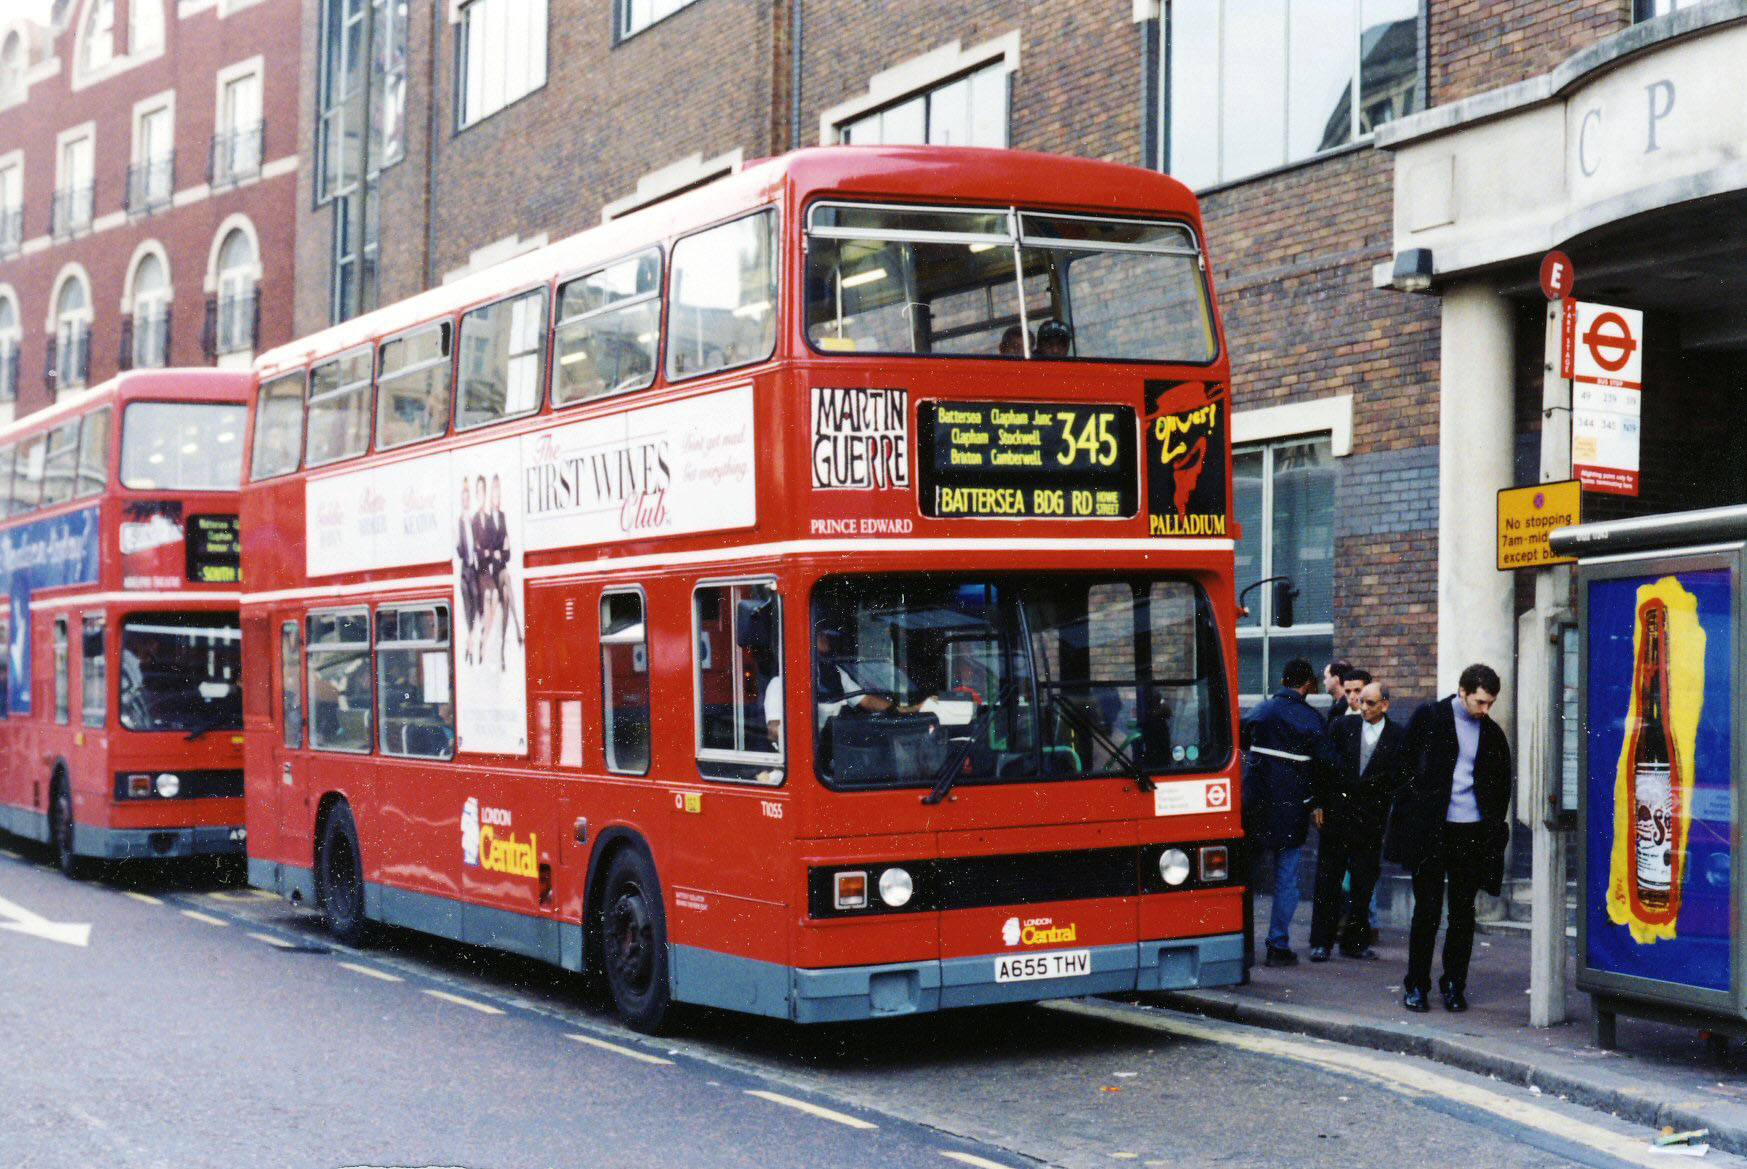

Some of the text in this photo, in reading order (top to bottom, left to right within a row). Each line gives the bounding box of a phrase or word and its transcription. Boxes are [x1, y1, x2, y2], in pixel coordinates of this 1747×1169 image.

[1551, 262, 1563, 289] E
[1597, 378, 1623, 387] BUS STOP
[816, 388, 904, 432] MARTIN
[938, 407, 1053, 427] Battersea Clapham Junc
[536, 433, 561, 461] The
[951, 428, 1042, 447] Clapham Stockwell
[1056, 412, 1118, 466] 345
[813, 434, 907, 488] GUERRE
[951, 448, 1043, 466] Brixton Camberwell
[526, 440, 671, 515] FIRST WIVES
[620, 487, 668, 532] Club
[941, 487, 1093, 515] BATTERSEA BDG RD
[1096, 503, 1119, 515] STREET
[811, 518, 913, 534] PRINCE EDWARD
[1149, 514, 1225, 535] PALLADIUM
[1506, 514, 1572, 530] No stopping
[1503, 549, 1538, 563] except
[481, 807, 512, 827] LONDON
[480, 824, 539, 879] Central
[1023, 918, 1052, 926] LONDON
[1021, 923, 1076, 945] Central
[1000, 954, 1087, 979] A655 THV
